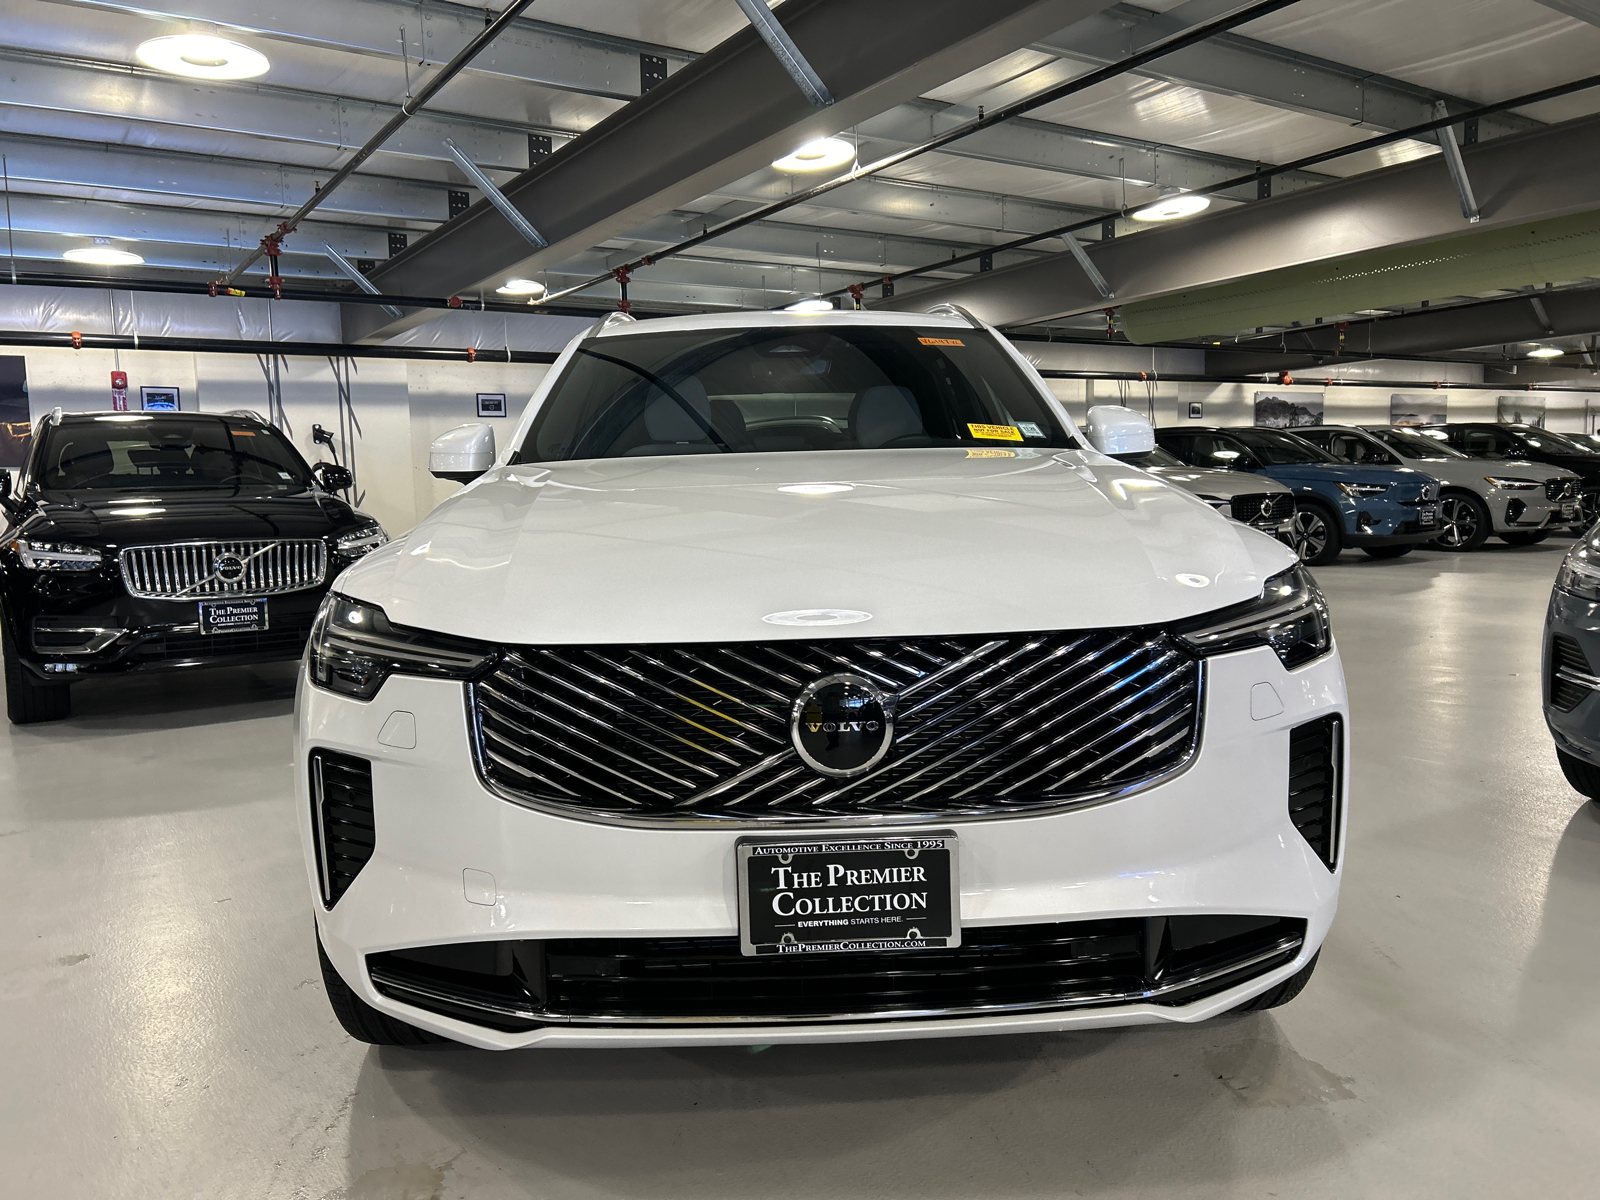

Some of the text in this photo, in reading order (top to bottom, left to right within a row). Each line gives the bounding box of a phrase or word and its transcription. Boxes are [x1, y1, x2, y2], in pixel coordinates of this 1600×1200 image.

[209, 606, 258, 615] THE PREMIER
[209, 614, 258, 623] COLLECTION
[805, 720, 879, 733] VOLVO
[754, 839, 944, 855] AUTOMOTIVE EXCELLENCE SINCE 1995
[770, 864, 927, 890] THE PREMIER
[771, 891, 928, 917] COLLECTION
[797, 915, 904, 928] EVERYTHING STARTS HERE.
